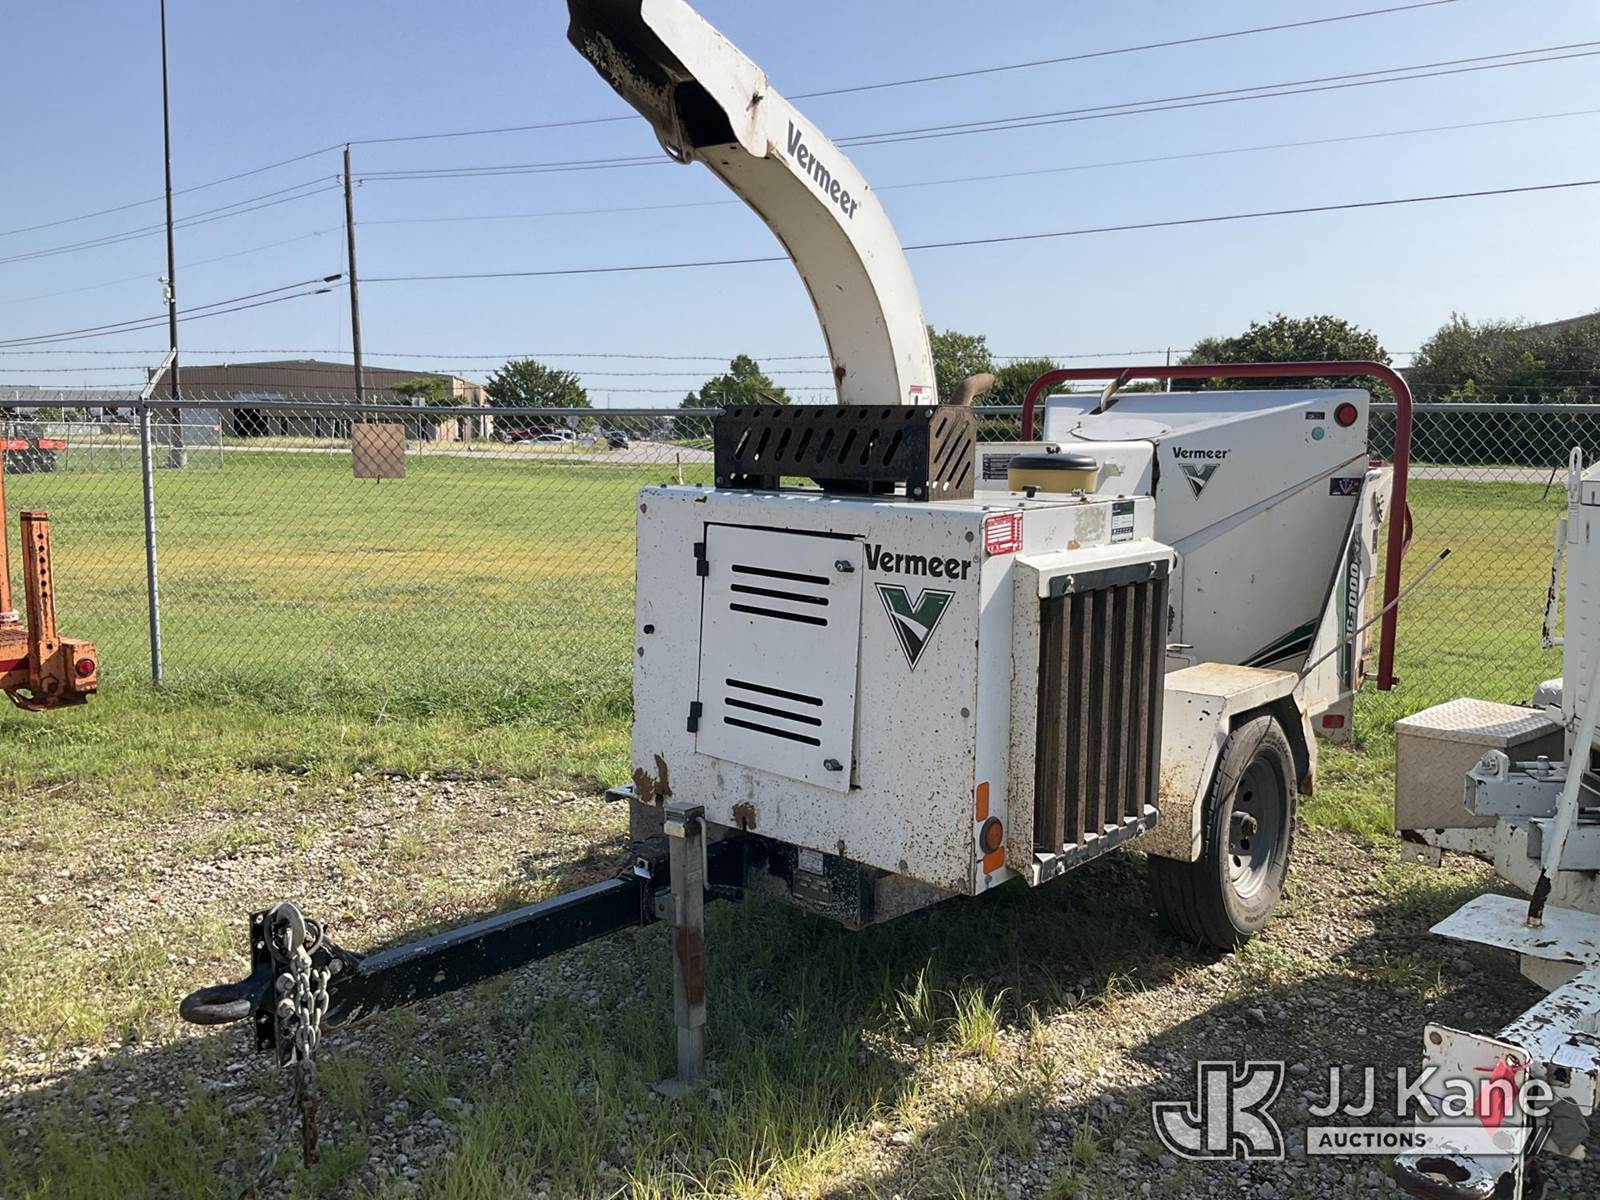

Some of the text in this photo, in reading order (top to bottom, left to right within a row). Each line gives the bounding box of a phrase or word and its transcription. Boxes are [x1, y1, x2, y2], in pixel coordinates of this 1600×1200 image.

[786, 120, 859, 220] Vermeer
[1172, 446, 1229, 459] Vermeer
[865, 543, 971, 580] Vermeer
